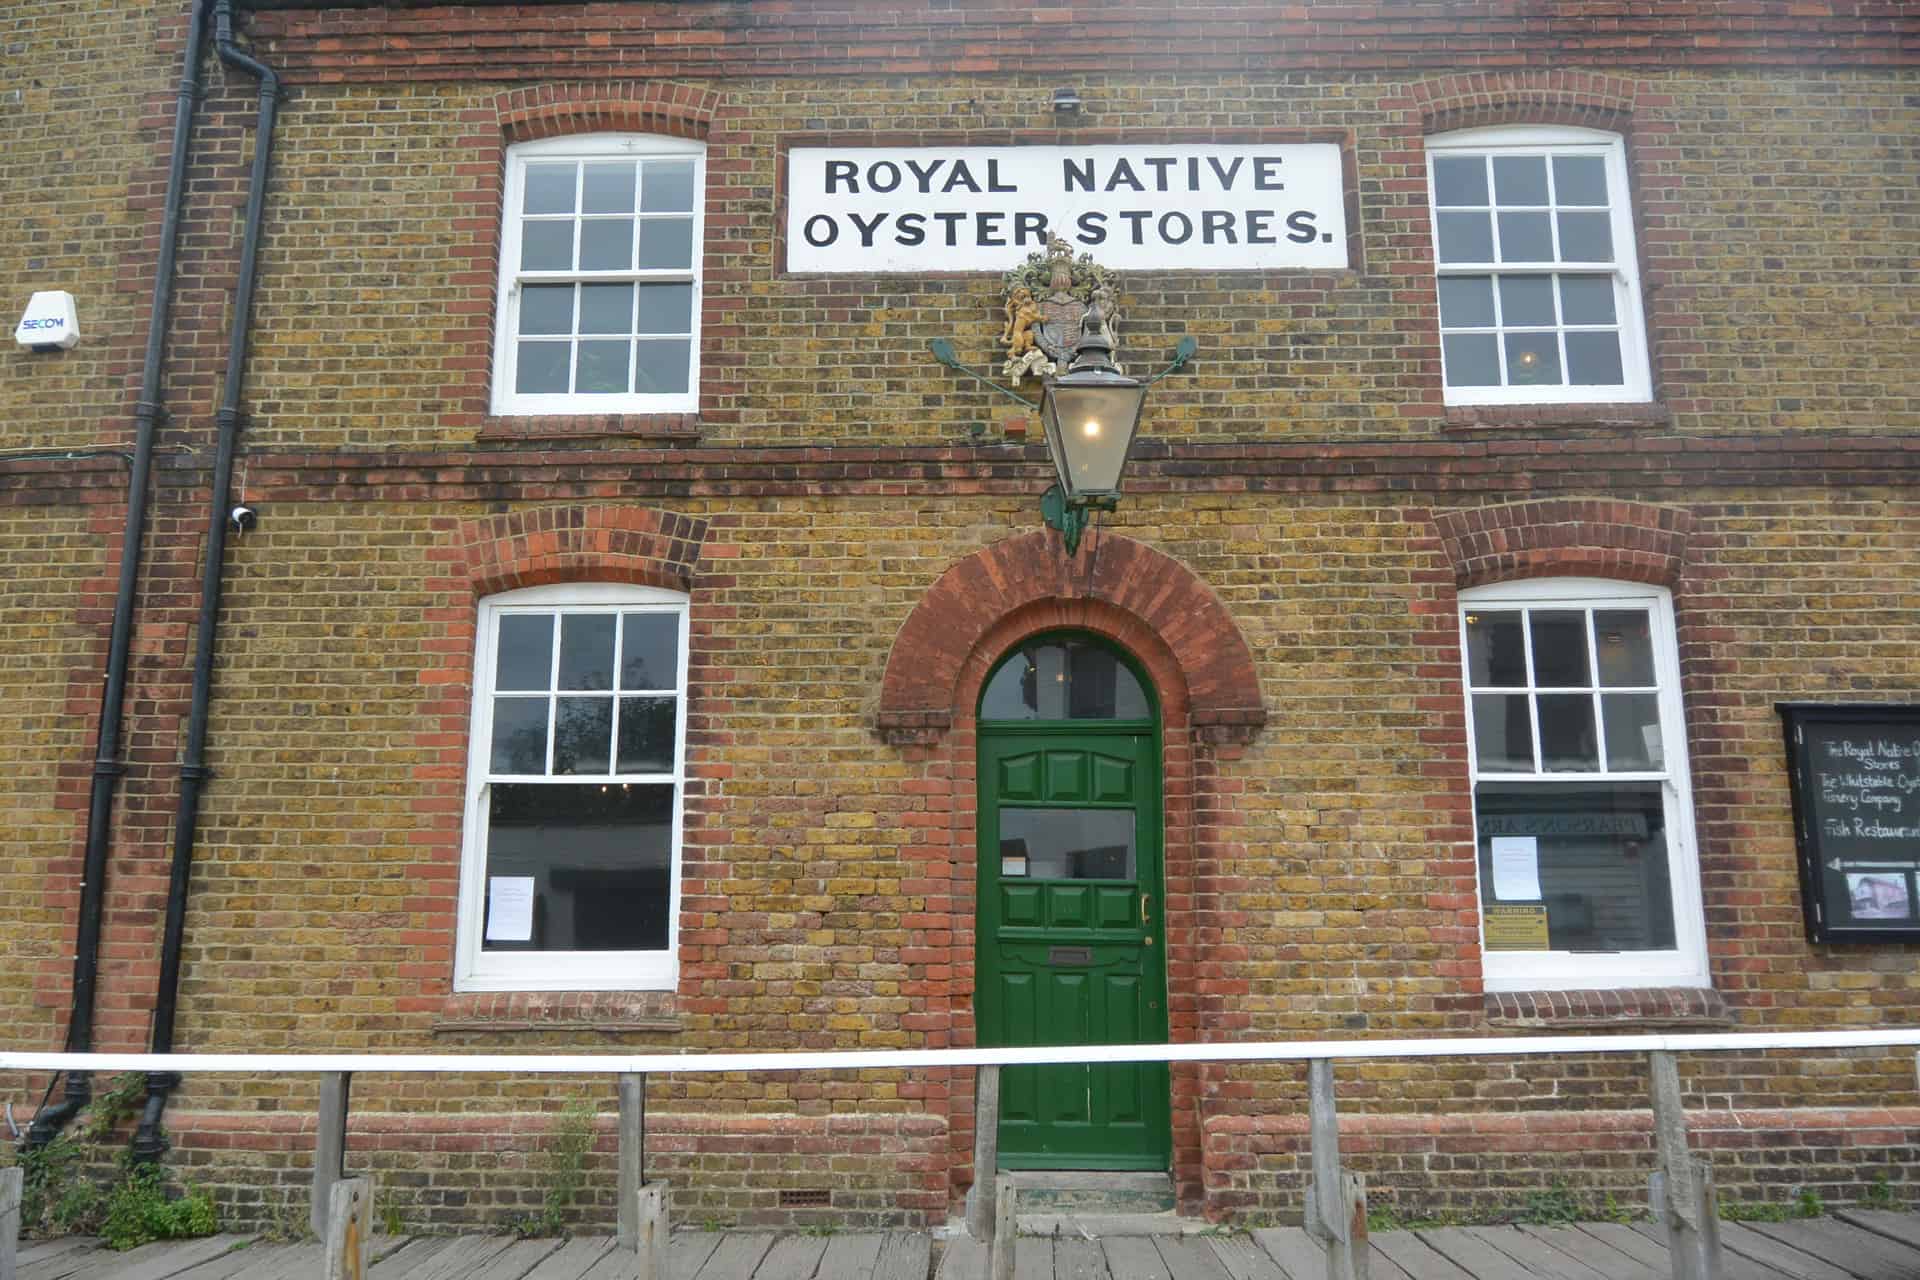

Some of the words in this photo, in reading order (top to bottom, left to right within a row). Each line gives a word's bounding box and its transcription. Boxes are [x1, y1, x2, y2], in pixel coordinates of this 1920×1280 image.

[824, 158, 1018, 194] ROYAL
[1063, 156, 1285, 192] NATIVE
[803, 211, 1049, 248] OYSTER
[1076, 209, 1334, 246] STORES.
[23, 317, 65, 330] SECOM
[1824, 818, 1851, 837] Fish
